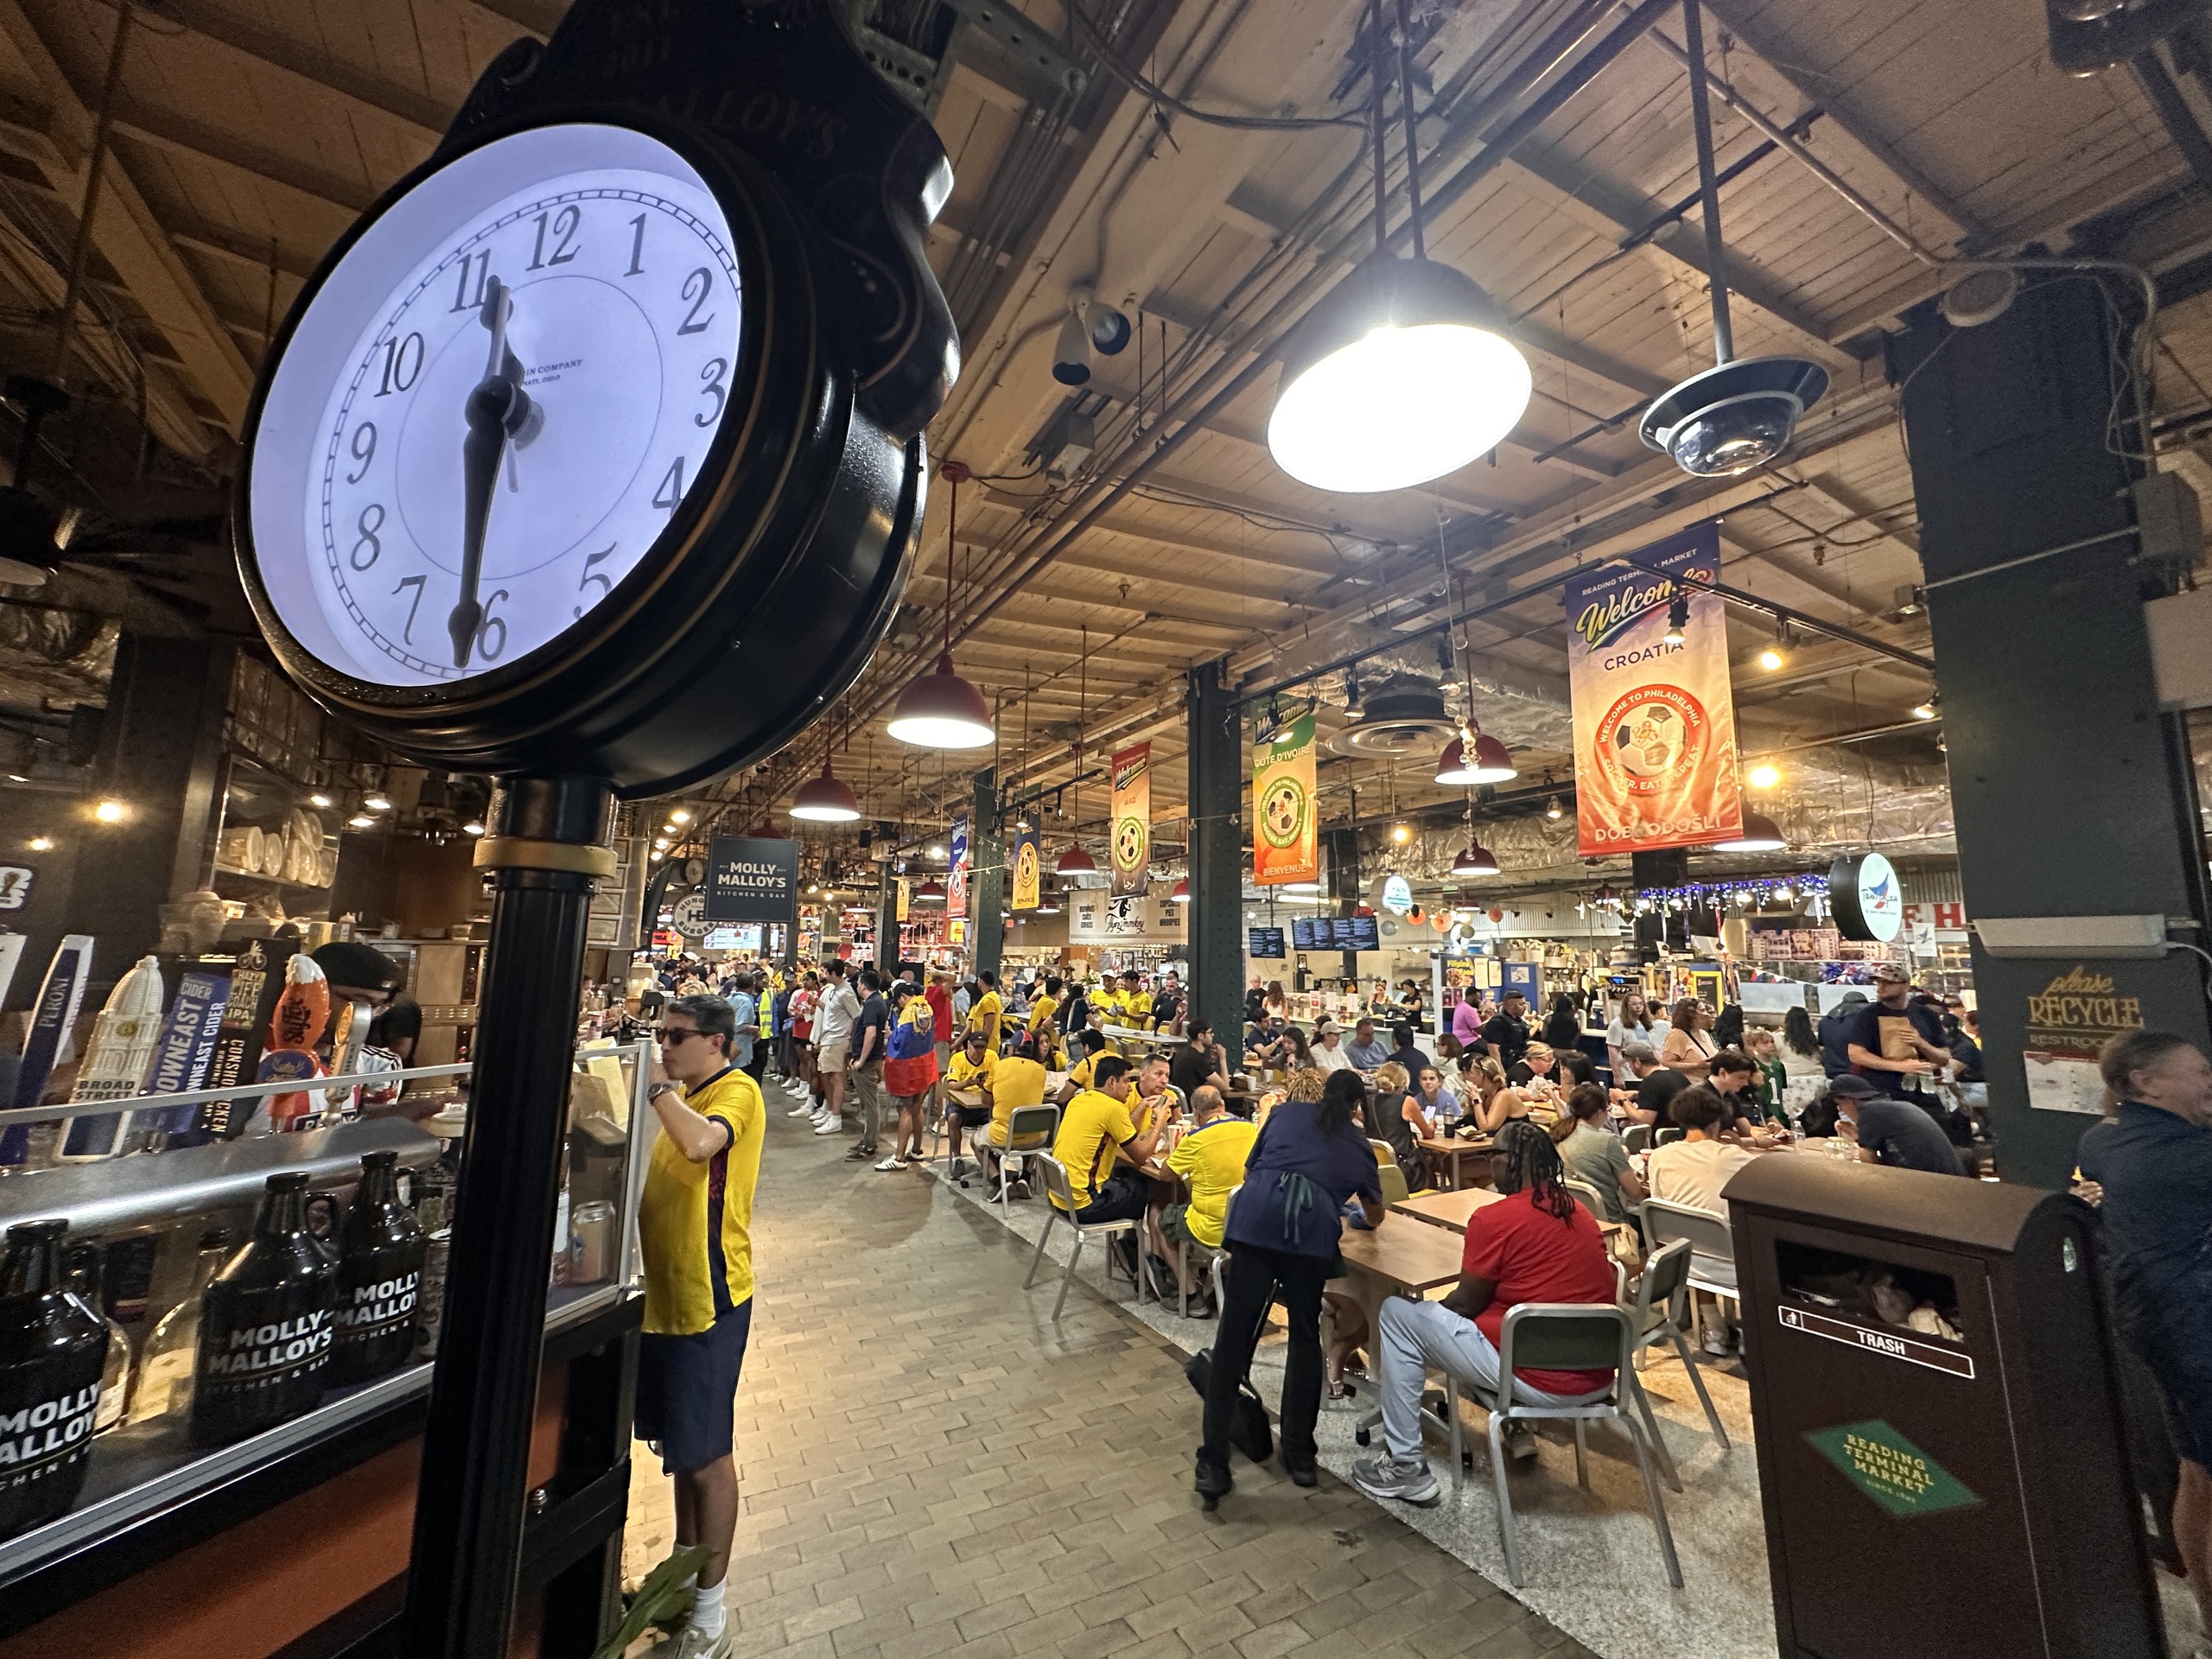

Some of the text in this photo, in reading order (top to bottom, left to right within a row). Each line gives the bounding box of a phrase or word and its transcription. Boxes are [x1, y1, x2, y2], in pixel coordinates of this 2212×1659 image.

[524, 204, 582, 271] 12
[624, 213, 647, 277] 1
[449, 248, 491, 313] 11
[677, 267, 715, 335] 2
[374, 332, 424, 397] 10
[537, 359, 583, 374] COMPANY
[695, 357, 727, 428] 3
[346, 422, 378, 484] 9
[651, 456, 686, 518] 4
[350, 504, 385, 571] 8
[574, 542, 617, 617] 5
[1581, 580, 1617, 596] READING
[1661, 549, 1697, 567] MARKET
[391, 575, 427, 645] 7
[476, 589, 510, 663] 6
[1604, 643, 1684, 671] CROATIA
[1599, 690, 1701, 743] WELCOME TO PHILADELPHIA
[1276, 744, 1312, 761] D'IVOIRE
[1668, 745, 1700, 782] EPEAT
[1594, 813, 1721, 842] DOBODOŠLI
[717, 874, 786, 887] MALLOY'S
[729, 861, 777, 875] MOLLY
[1262, 865, 1307, 877] BIENVENUE
[679, 896, 705, 912] HUNG
[678, 920, 715, 935] BURGER
[180, 982, 213, 1001] CIDER
[238, 971, 259, 982] HAZY
[37, 976, 70, 1028] PERONI
[227, 995, 258, 1011] COACH
[227, 1009, 251, 1020] IPA
[2027, 995, 2145, 1029] RECYCLE
[185, 1001, 226, 1092] WNEAST CIDER
[2031, 1034, 2105, 1048] RESTROO
[74, 1090, 133, 1100] STREET
[79, 1080, 136, 1089] BROAD
[211, 1039, 245, 1133] CONSHOCKEN
[1768, 1077, 1780, 1104] 1
[230, 1308, 325, 1349] MOLLY
[1856, 1330, 1906, 1356] TRASH
[207, 1325, 334, 1375] MALLOY'S
[0, 1409, 96, 1465] ALLOY
[1847, 1433, 1926, 1471] READING
[1843, 1444, 1935, 1485] TERMINAL
[1853, 1459, 1926, 1494] MARKET
